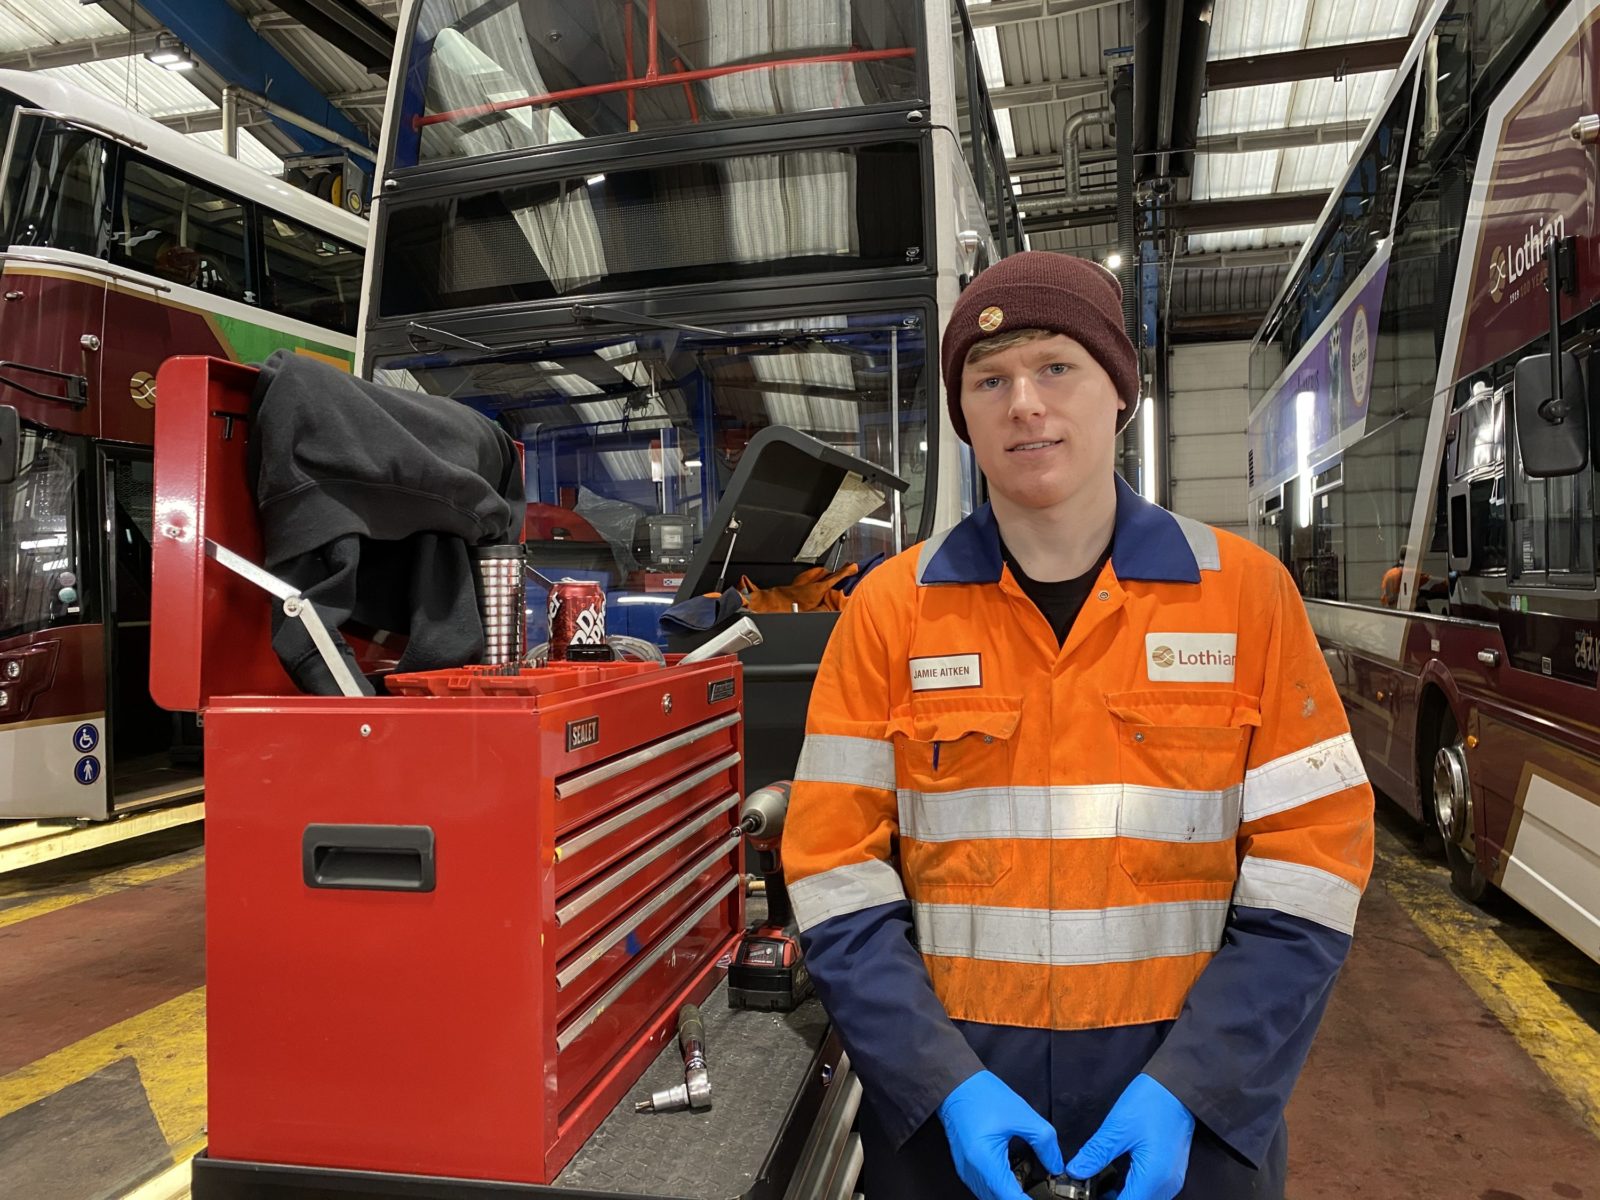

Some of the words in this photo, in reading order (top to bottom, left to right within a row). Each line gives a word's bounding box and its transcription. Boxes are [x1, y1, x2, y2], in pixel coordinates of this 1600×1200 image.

[1507, 213, 1565, 284] Lothian
[913, 668, 938, 680] JAMIE
[940, 666, 970, 678] AITKEN
[572, 721, 597, 746] SEALEY
